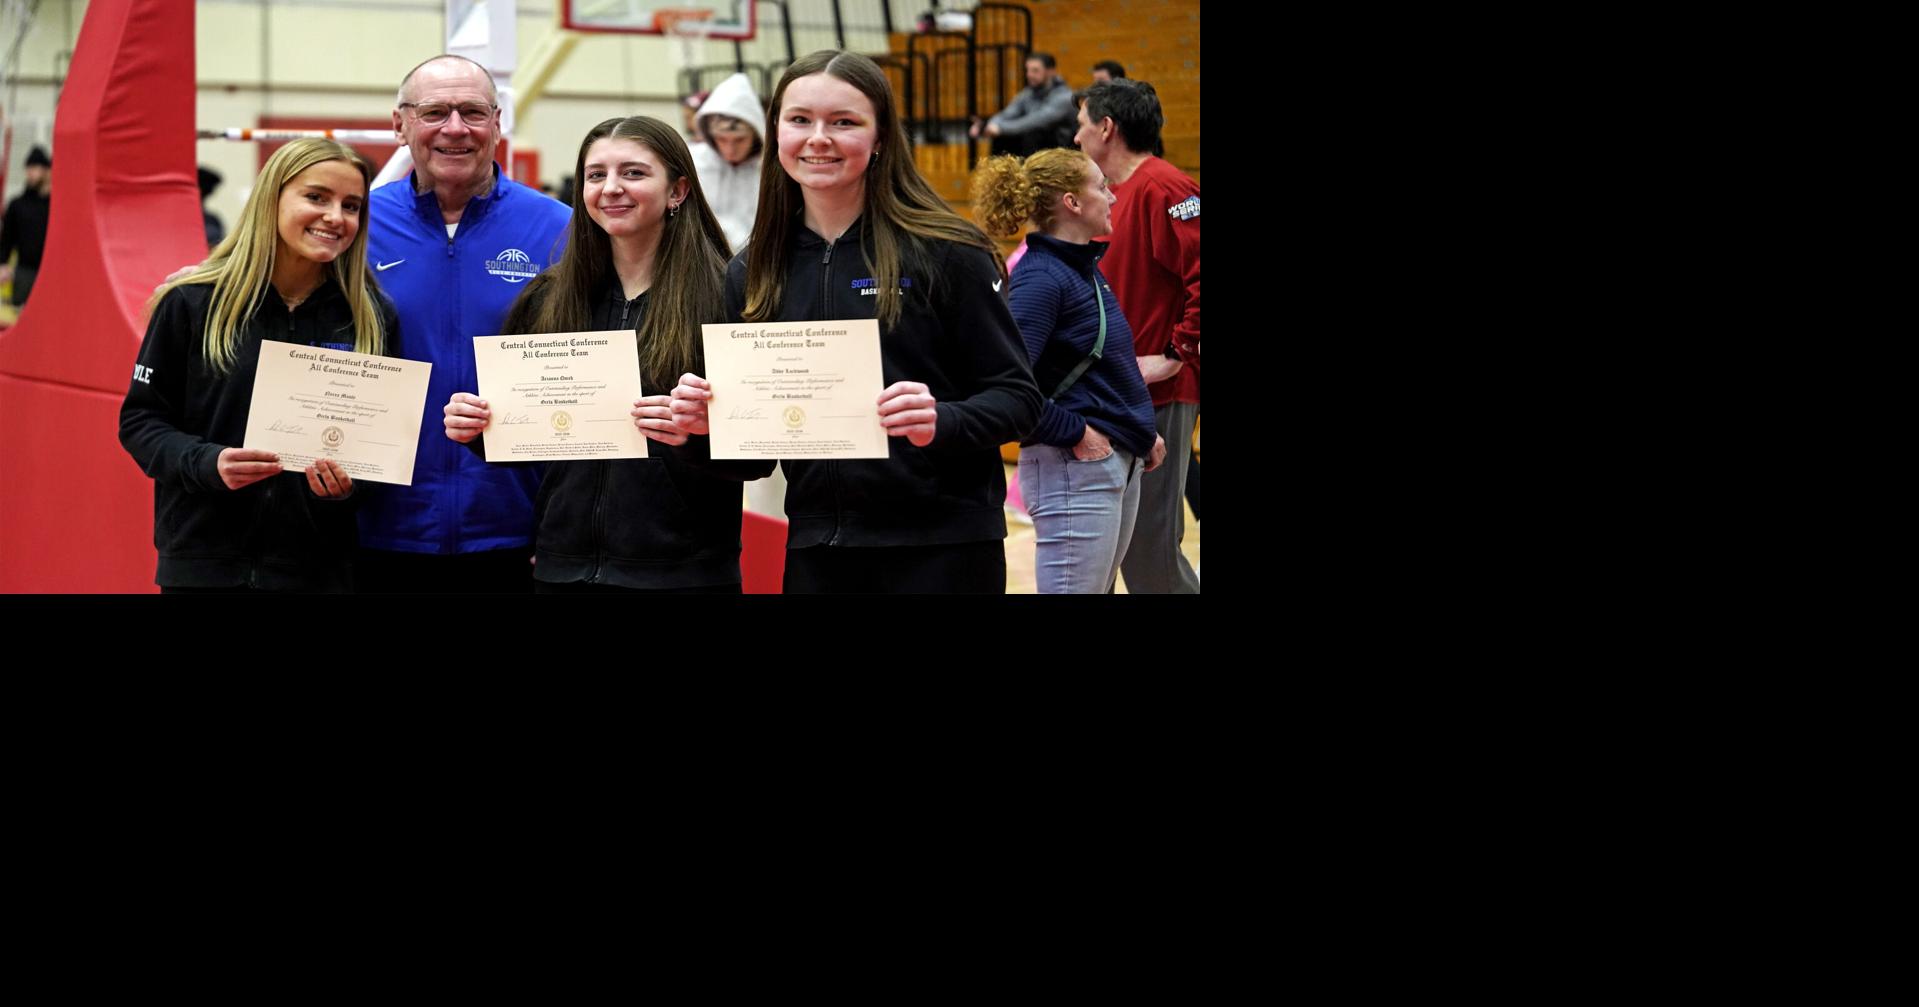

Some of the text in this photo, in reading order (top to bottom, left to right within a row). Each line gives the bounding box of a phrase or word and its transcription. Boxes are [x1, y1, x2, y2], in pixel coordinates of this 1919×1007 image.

[1168, 200, 1200, 214] WORL
[485, 260, 540, 272] SOUTHINGTON
[731, 328, 847, 338] Central Connecticut Conference
[501, 341, 526, 349] Central
[528, 340, 568, 348] Connecticut
[753, 341, 764, 350] All
[766, 340, 804, 348] Conference
[522, 351, 533, 360] All
[535, 350, 568, 358] Conference
[290, 350, 402, 372] Central Connecticut Conference
[309, 363, 379, 379] All Conference Team
